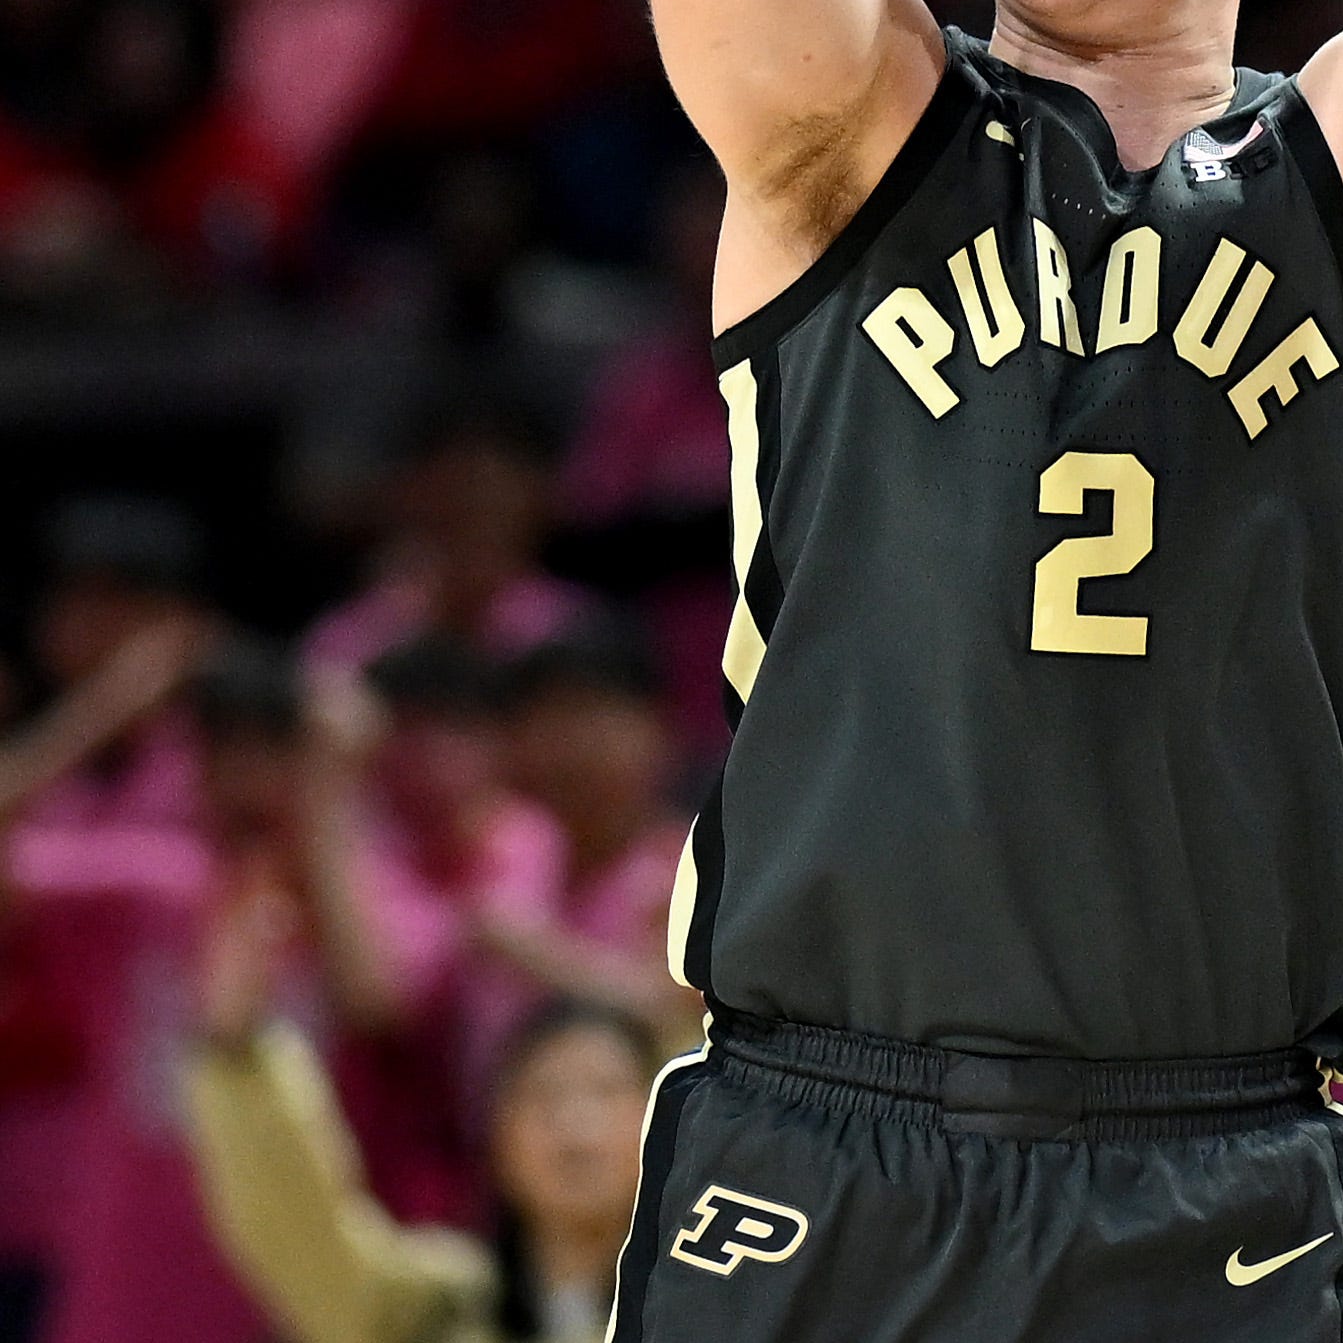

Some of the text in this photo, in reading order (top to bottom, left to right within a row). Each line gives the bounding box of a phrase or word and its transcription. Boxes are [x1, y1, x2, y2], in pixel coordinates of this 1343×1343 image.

[861, 217, 1341, 441] PURDUE
[1029, 450, 1155, 657] 2
[670, 1184, 809, 1275] P
